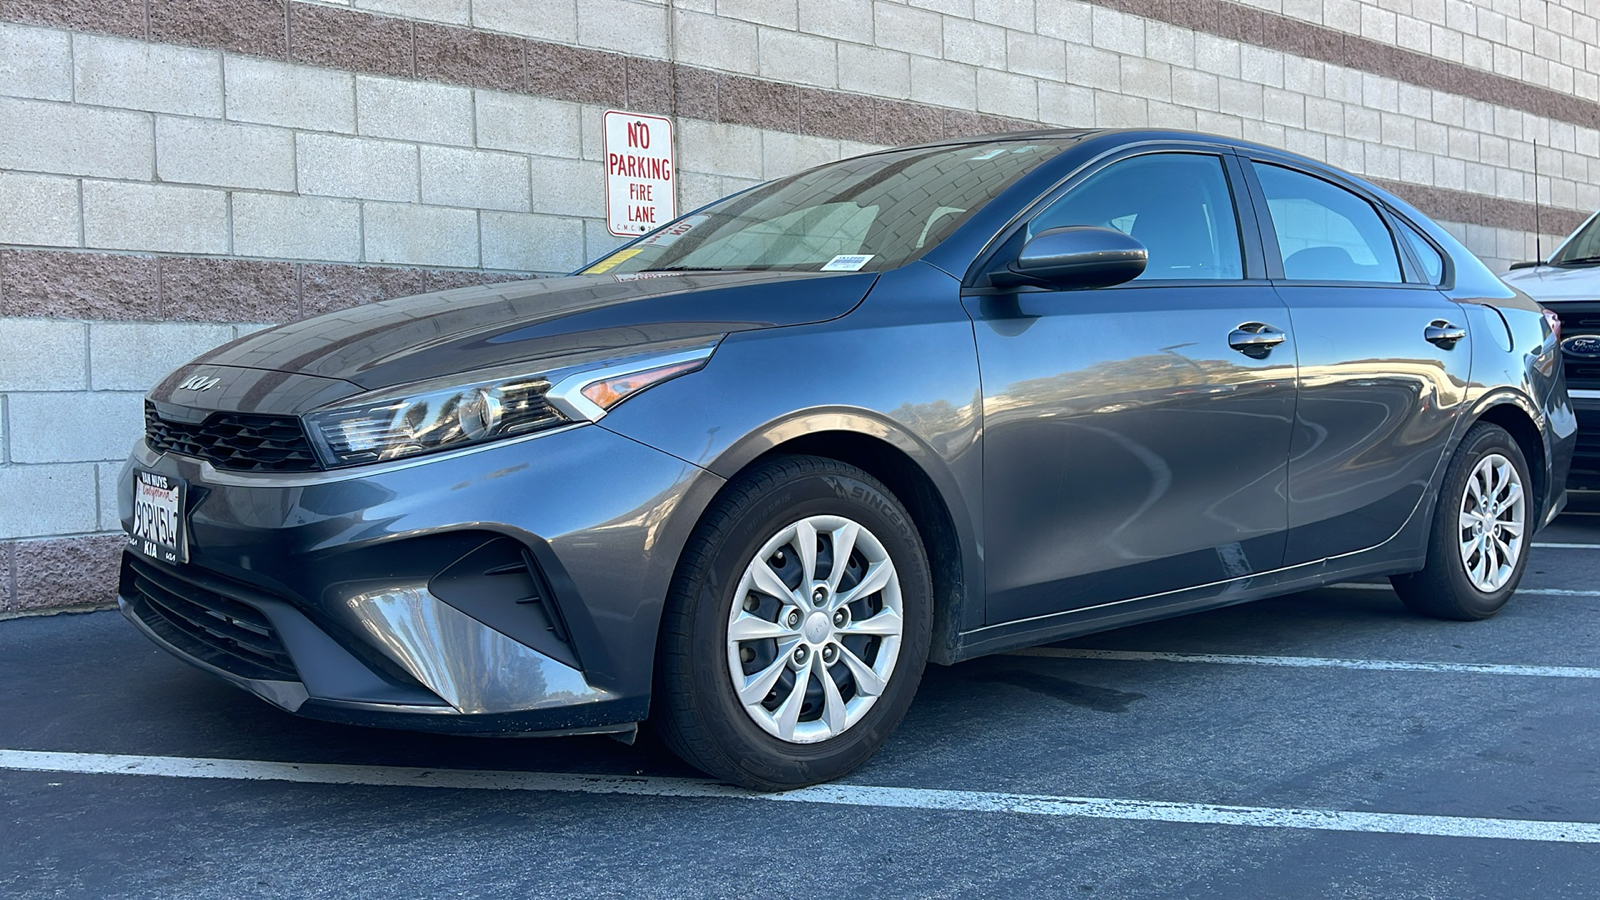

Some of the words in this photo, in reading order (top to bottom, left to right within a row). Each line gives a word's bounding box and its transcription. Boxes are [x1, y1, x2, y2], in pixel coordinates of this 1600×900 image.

[627, 122, 650, 149] NO
[609, 153, 671, 181] PARKING
[629, 183, 653, 202] FIRE
[628, 205, 656, 223] LANE
[151, 474, 168, 489] NUYS
[850, 486, 917, 549] SINCERA
[143, 540, 158, 559] KIA
